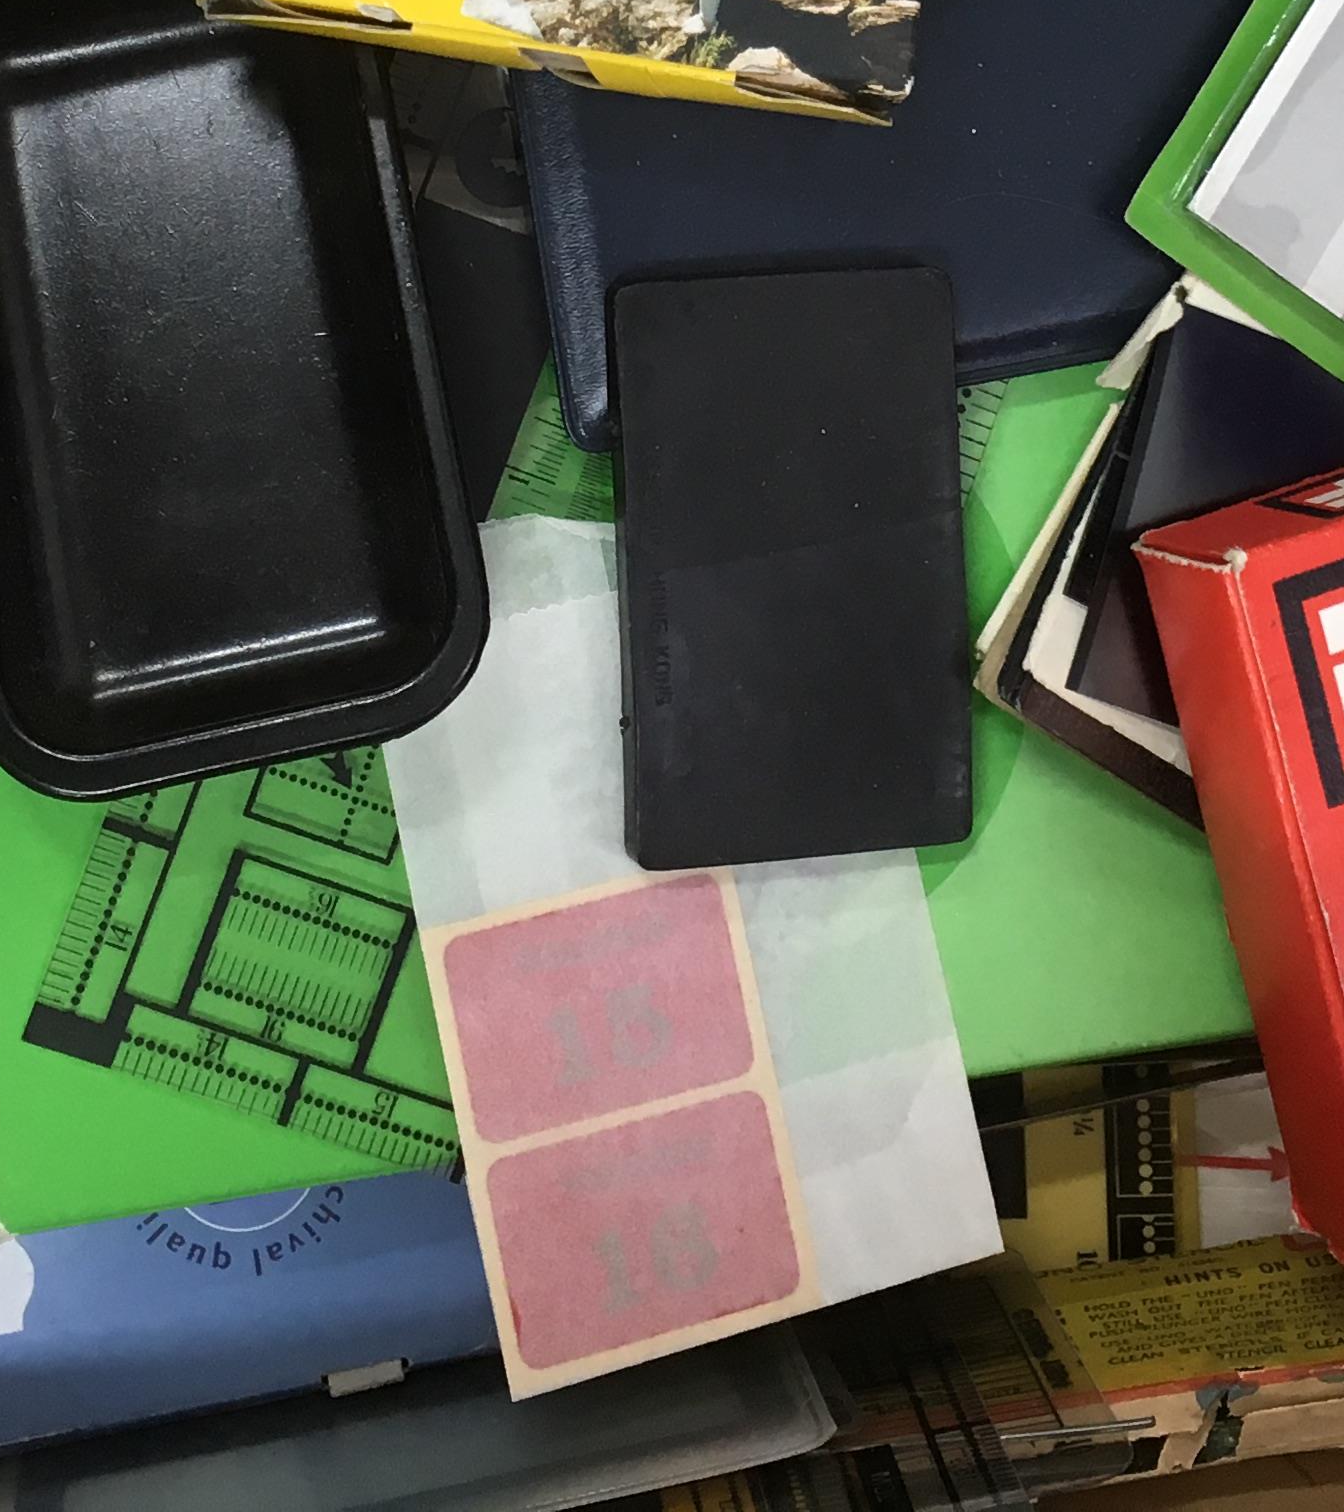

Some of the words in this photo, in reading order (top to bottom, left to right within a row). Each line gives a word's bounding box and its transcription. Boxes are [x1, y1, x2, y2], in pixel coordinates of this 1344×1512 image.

[105, 925, 134, 952] 14
[372, 1091, 399, 1119] 15
[134, 1210, 232, 1272] quali
[252, 1185, 344, 1278] chival
[1164, 1267, 1242, 1286] HINTS
[1259, 1260, 1290, 1274] ON
[1084, 1300, 1131, 1313] HOLD
[1142, 1294, 1174, 1306] THE
[1259, 1280, 1290, 1289] PEN
[1088, 1309, 1138, 1323] WASH
[1148, 1303, 1182, 1314] OUT
[1198, 1298, 1229, 1308] THE
[1239, 1293, 1272, 1302] PEN
[1153, 1312, 1181, 1322] USE
[1108, 1351, 1164, 1365] CLEAN
[1216, 1345, 1287, 1360] STENCIL
